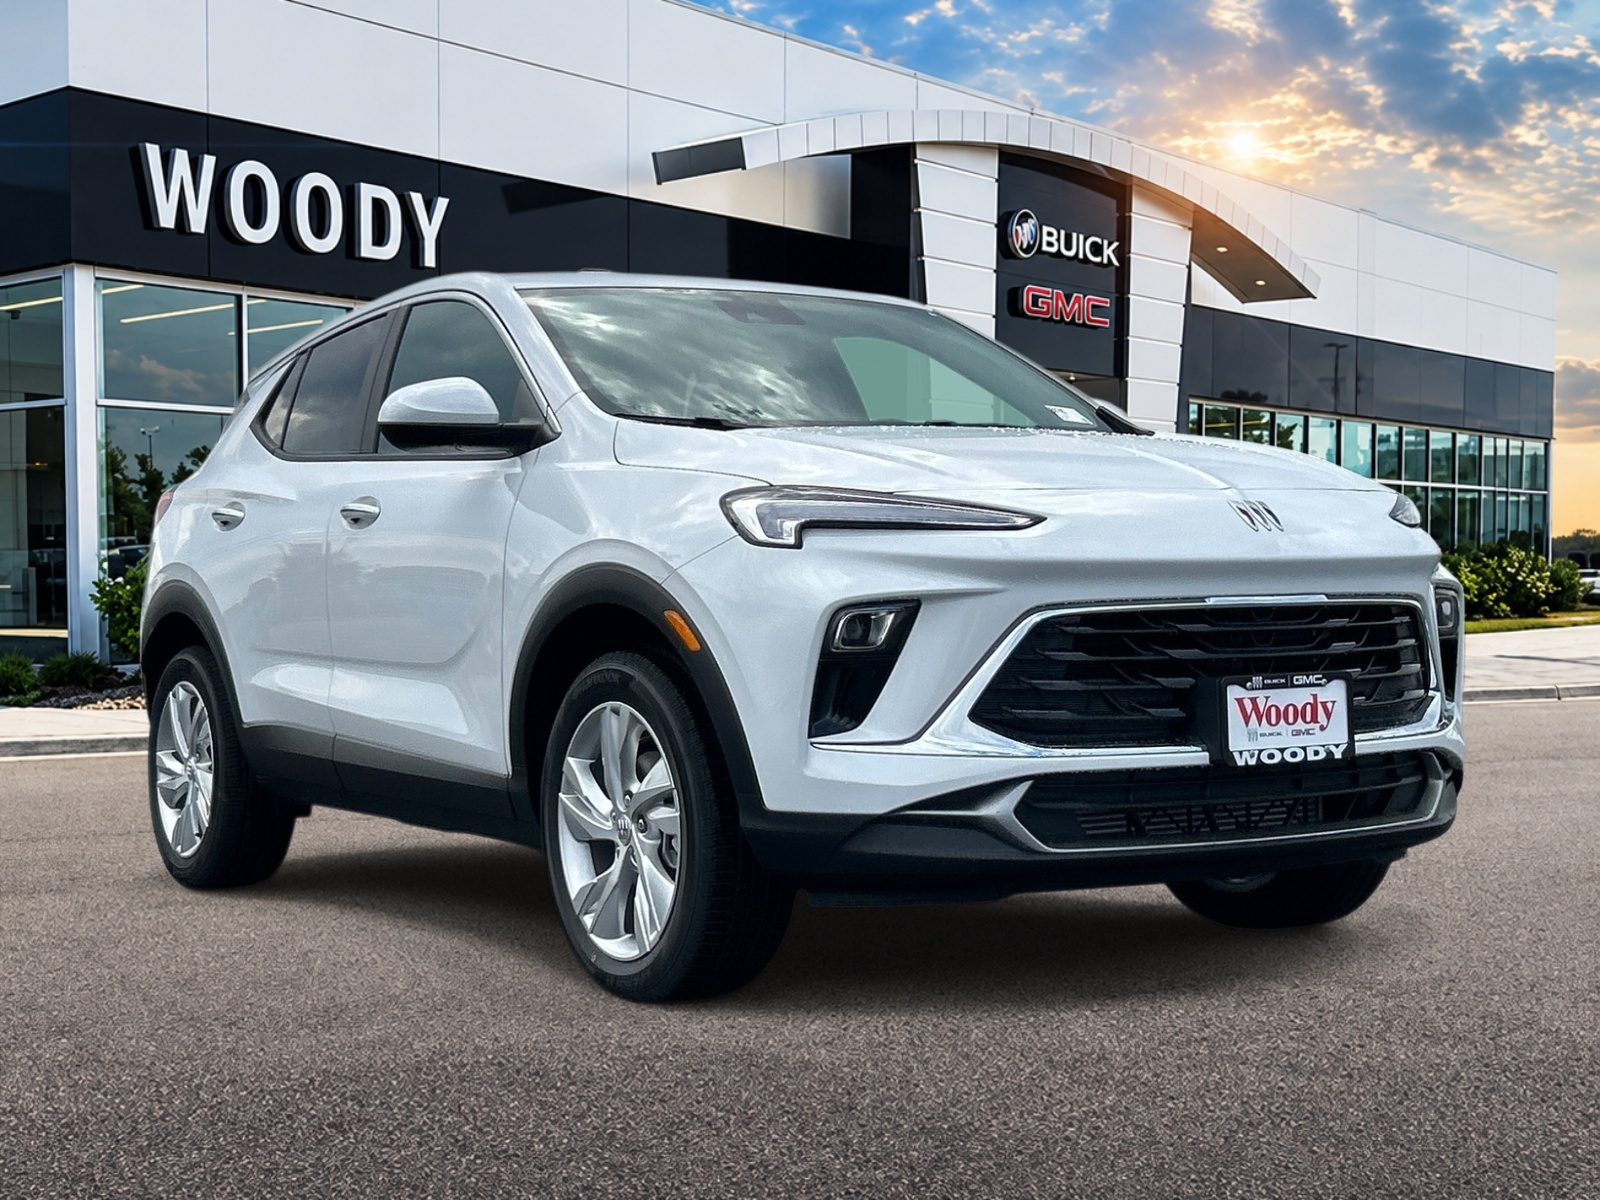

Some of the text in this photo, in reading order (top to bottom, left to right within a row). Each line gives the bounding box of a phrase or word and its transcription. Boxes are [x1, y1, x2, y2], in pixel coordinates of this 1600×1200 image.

[142, 142, 449, 268] WOODY
[1041, 225, 1120, 266] BUICK
[1023, 285, 1110, 327] GMC
[1293, 675, 1324, 685] GMC
[1234, 694, 1337, 732] Woody
[1291, 728, 1316, 736] GMC
[1233, 744, 1348, 767] WOODY
